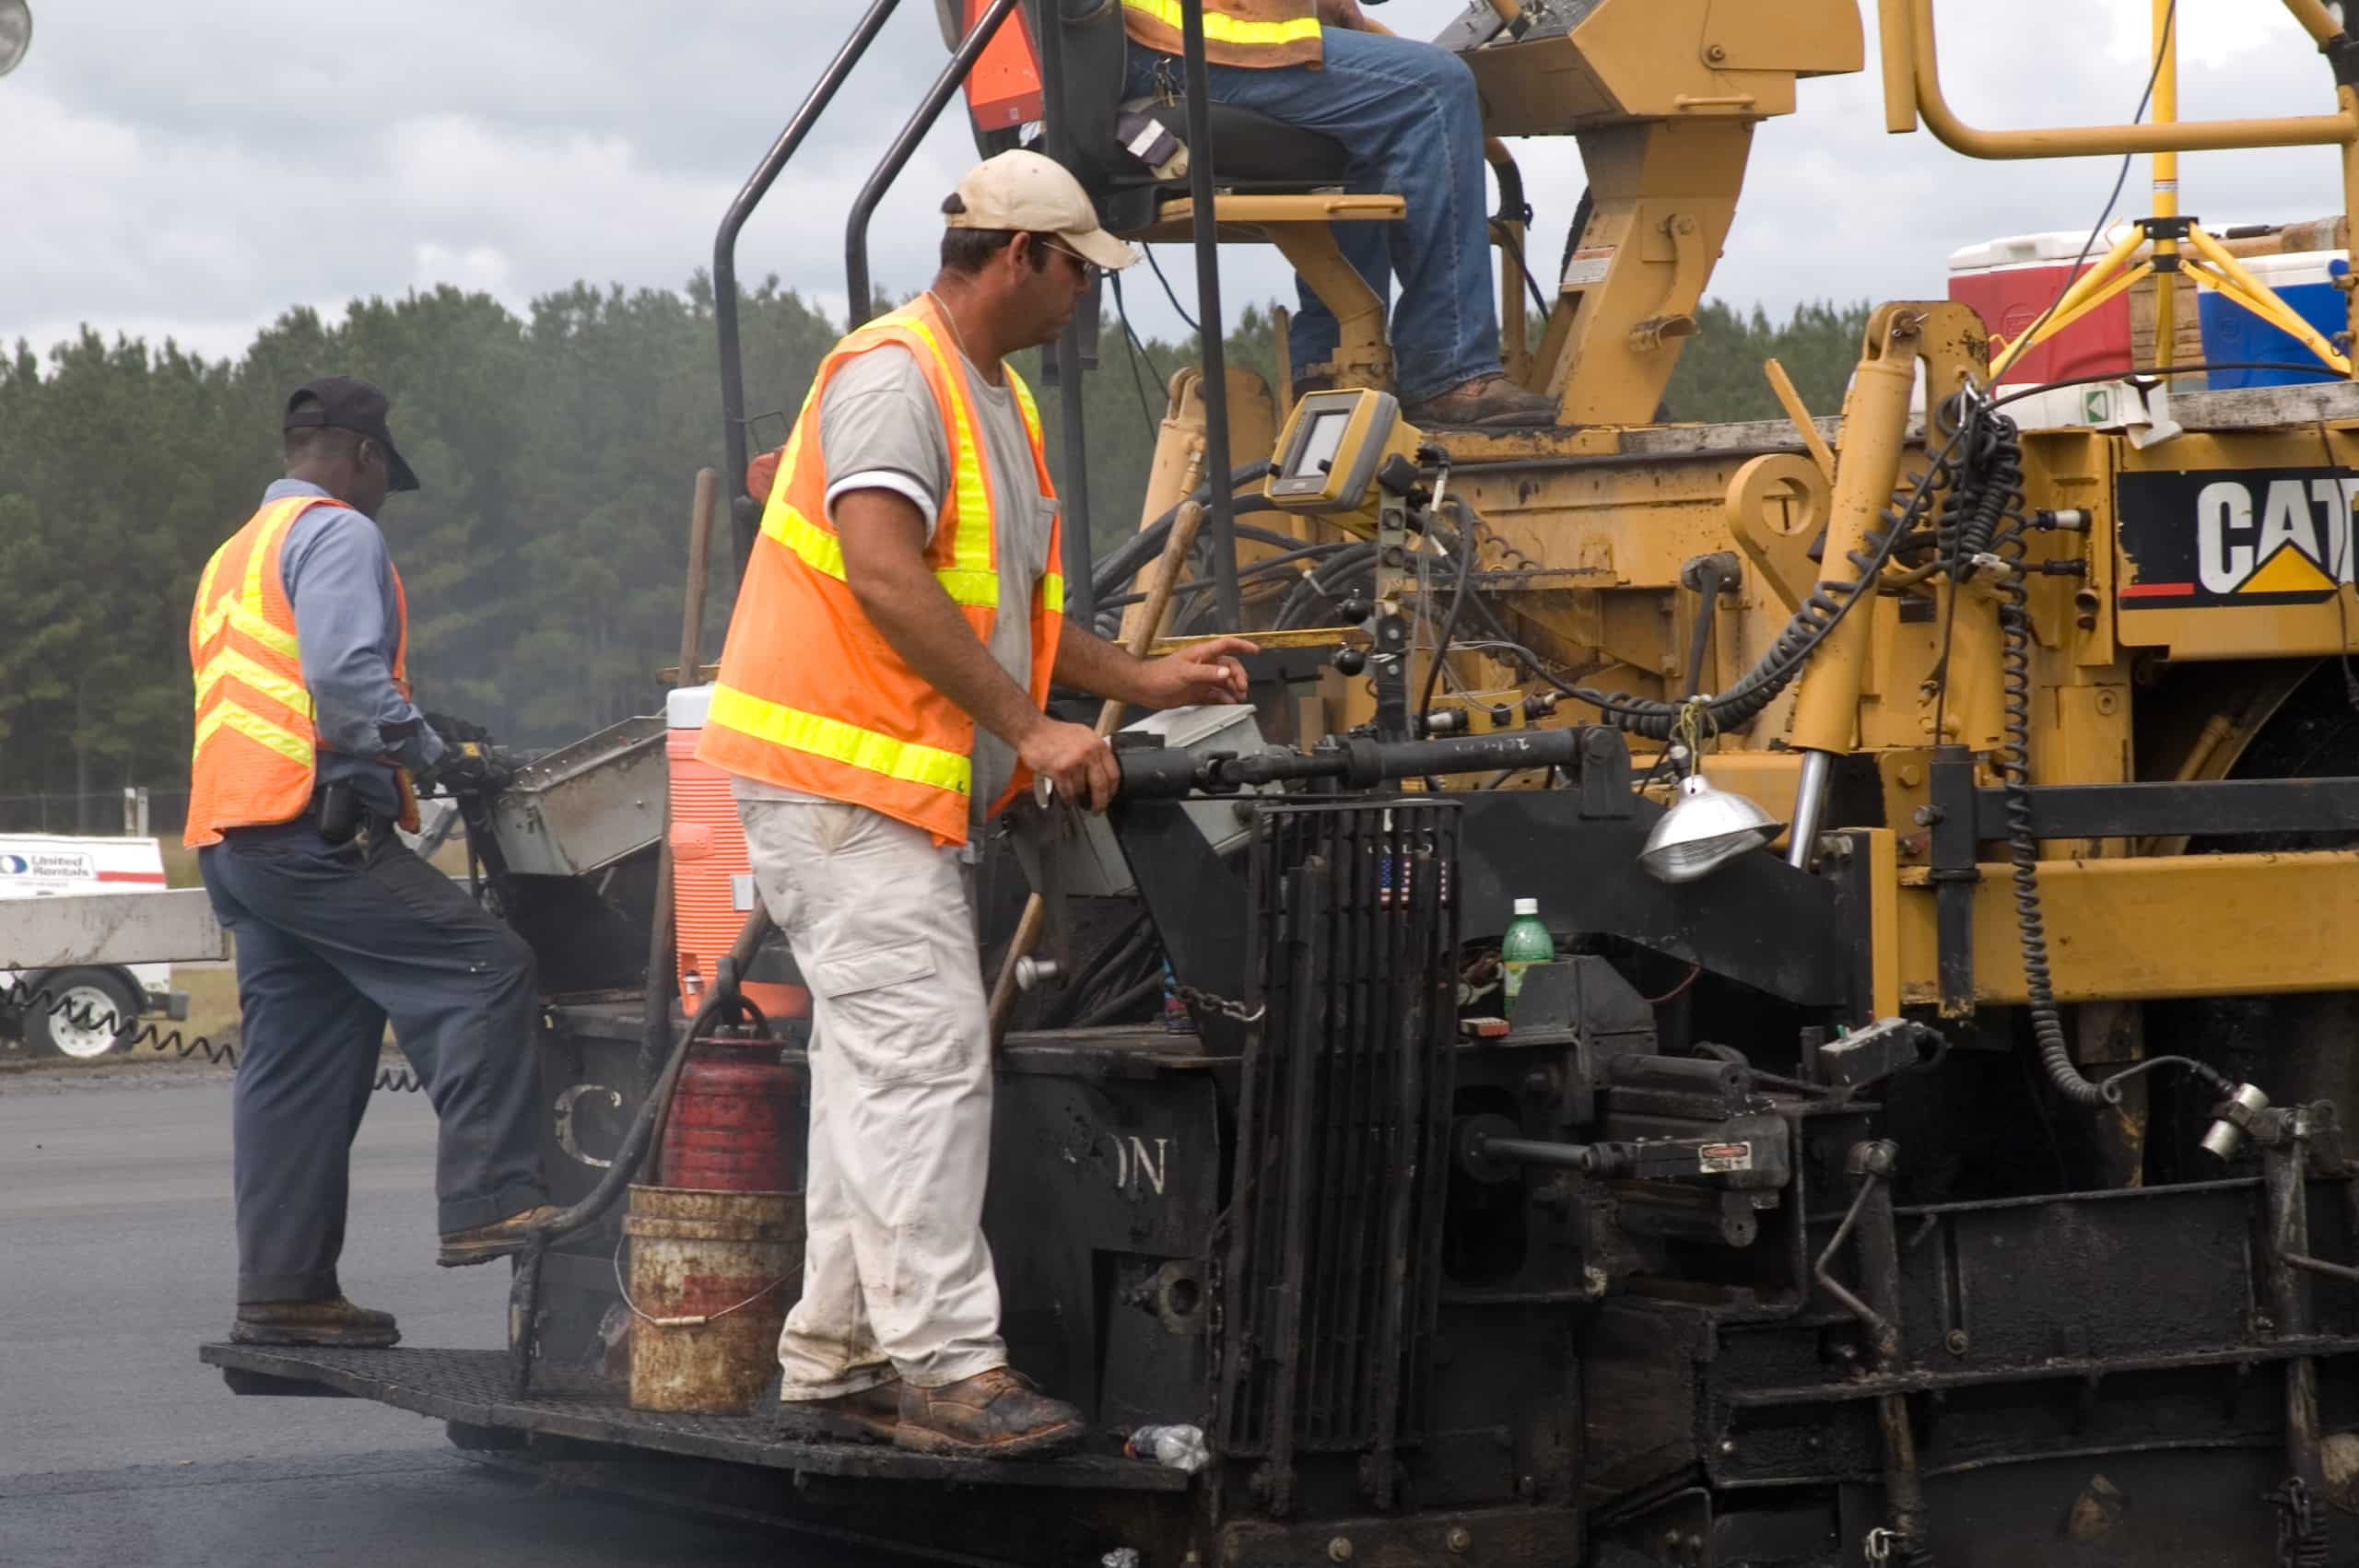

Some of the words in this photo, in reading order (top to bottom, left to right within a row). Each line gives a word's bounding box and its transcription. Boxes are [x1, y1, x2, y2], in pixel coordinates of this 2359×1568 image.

[2197, 475, 2359, 594] CAT
[30, 855, 83, 867] United
[32, 866, 89, 877] Rentals
